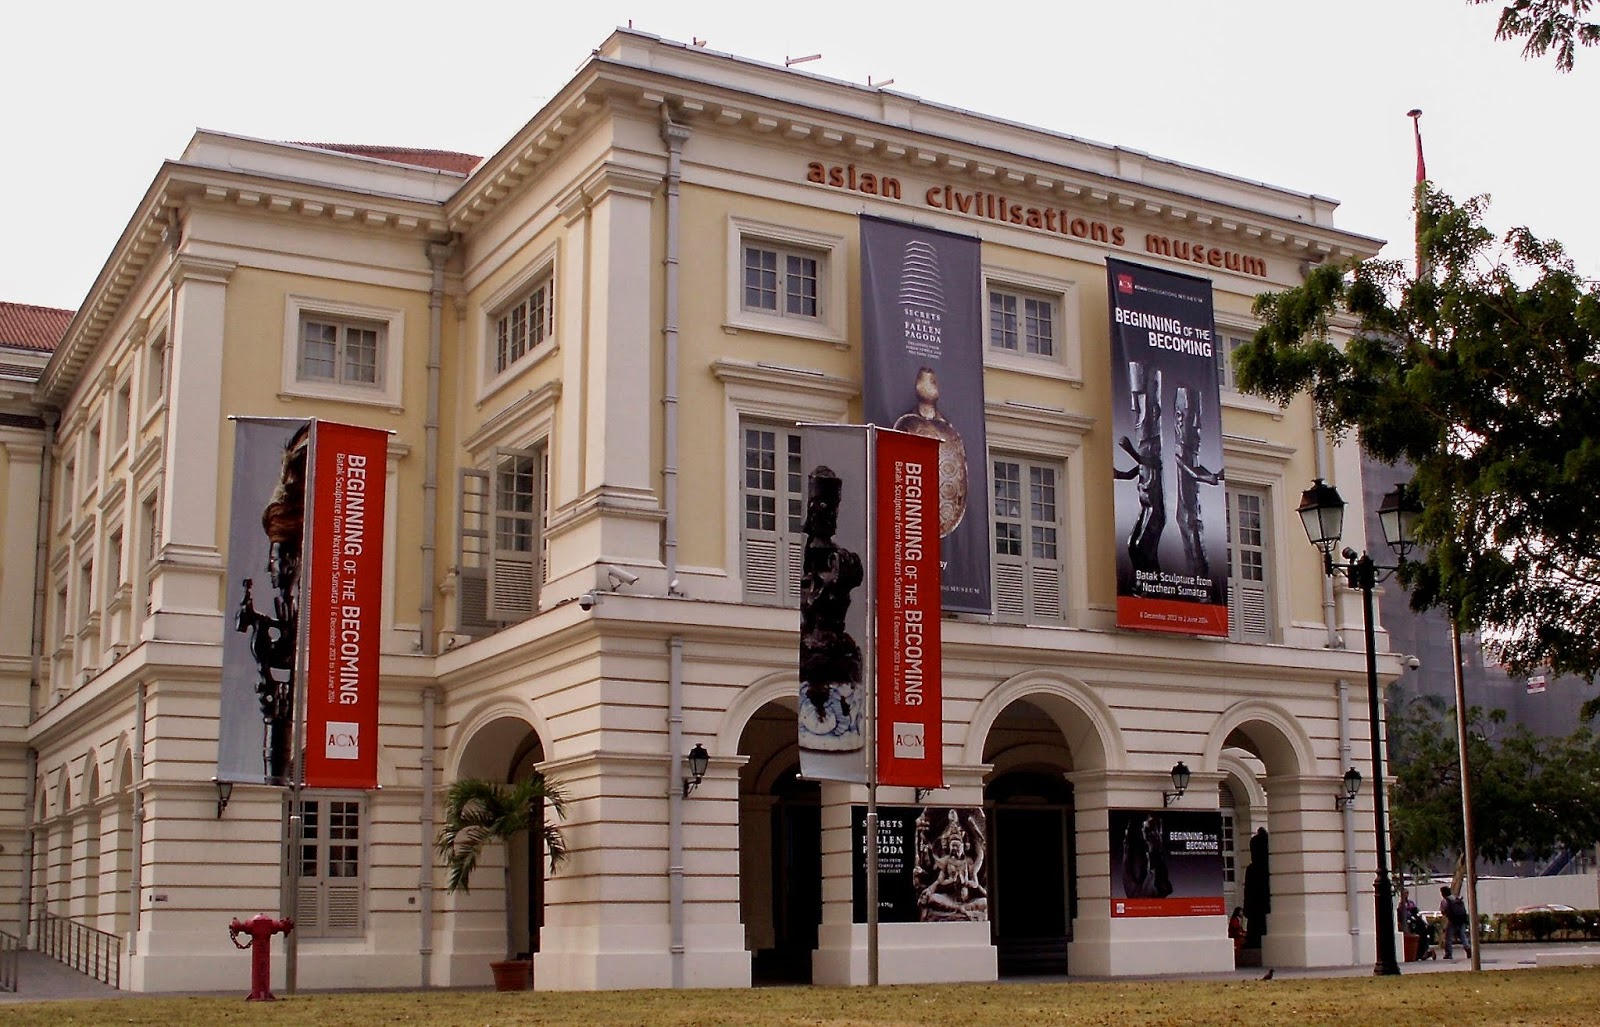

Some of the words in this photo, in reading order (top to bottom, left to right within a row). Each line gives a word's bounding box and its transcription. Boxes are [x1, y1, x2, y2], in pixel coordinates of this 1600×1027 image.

[806, 161, 901, 200] asian
[926, 184, 1126, 247] civilisations
[1145, 233, 1267, 278] museum
[904, 308, 941, 321] SECRETS
[1115, 307, 1182, 335] BEGINNING
[1183, 326, 1193, 337] OF
[1195, 328, 1211, 341] THE
[904, 321, 941, 335] FALLEN
[905, 330, 941, 343] PAGODA
[1148, 331, 1212, 358] BECOMING
[336, 453, 345, 476] Batak
[894, 461, 904, 483] Batak
[333, 477, 345, 515] Sculpture
[344, 454, 367, 556] BEGINNING
[893, 485, 904, 522] Sculpture
[904, 462, 923, 561] BEGINNING
[334, 515, 344, 533] from
[894, 523, 904, 540] from
[332, 535, 342, 571] Northern
[894, 541, 903, 577] Northern
[343, 560, 357, 575] OF
[904, 565, 918, 580] OF
[1135, 569, 1158, 581] Batak
[1160, 572, 1195, 585] Sculpture
[1196, 575, 1212, 587] from
[331, 571, 341, 604] Sumatra
[342, 578, 356, 601] THE
[894, 576, 904, 609] Sumatra
[904, 583, 918, 606] THE
[1142, 582, 1176, 595] Northern
[1177, 586, 1207, 598] Sumatra
[339, 605, 361, 705] BECOMING
[904, 610, 923, 706] BECOMING
[328, 733, 359, 747] ACM
[896, 734, 925, 748] ACM
[862, 820, 904, 828] SRETS
[862, 835, 904, 845] FLLEN
[1170, 831, 1204, 841] BEGINNING
[1186, 841, 1219, 850] BECOMING
[862, 845, 904, 854] PGODA
